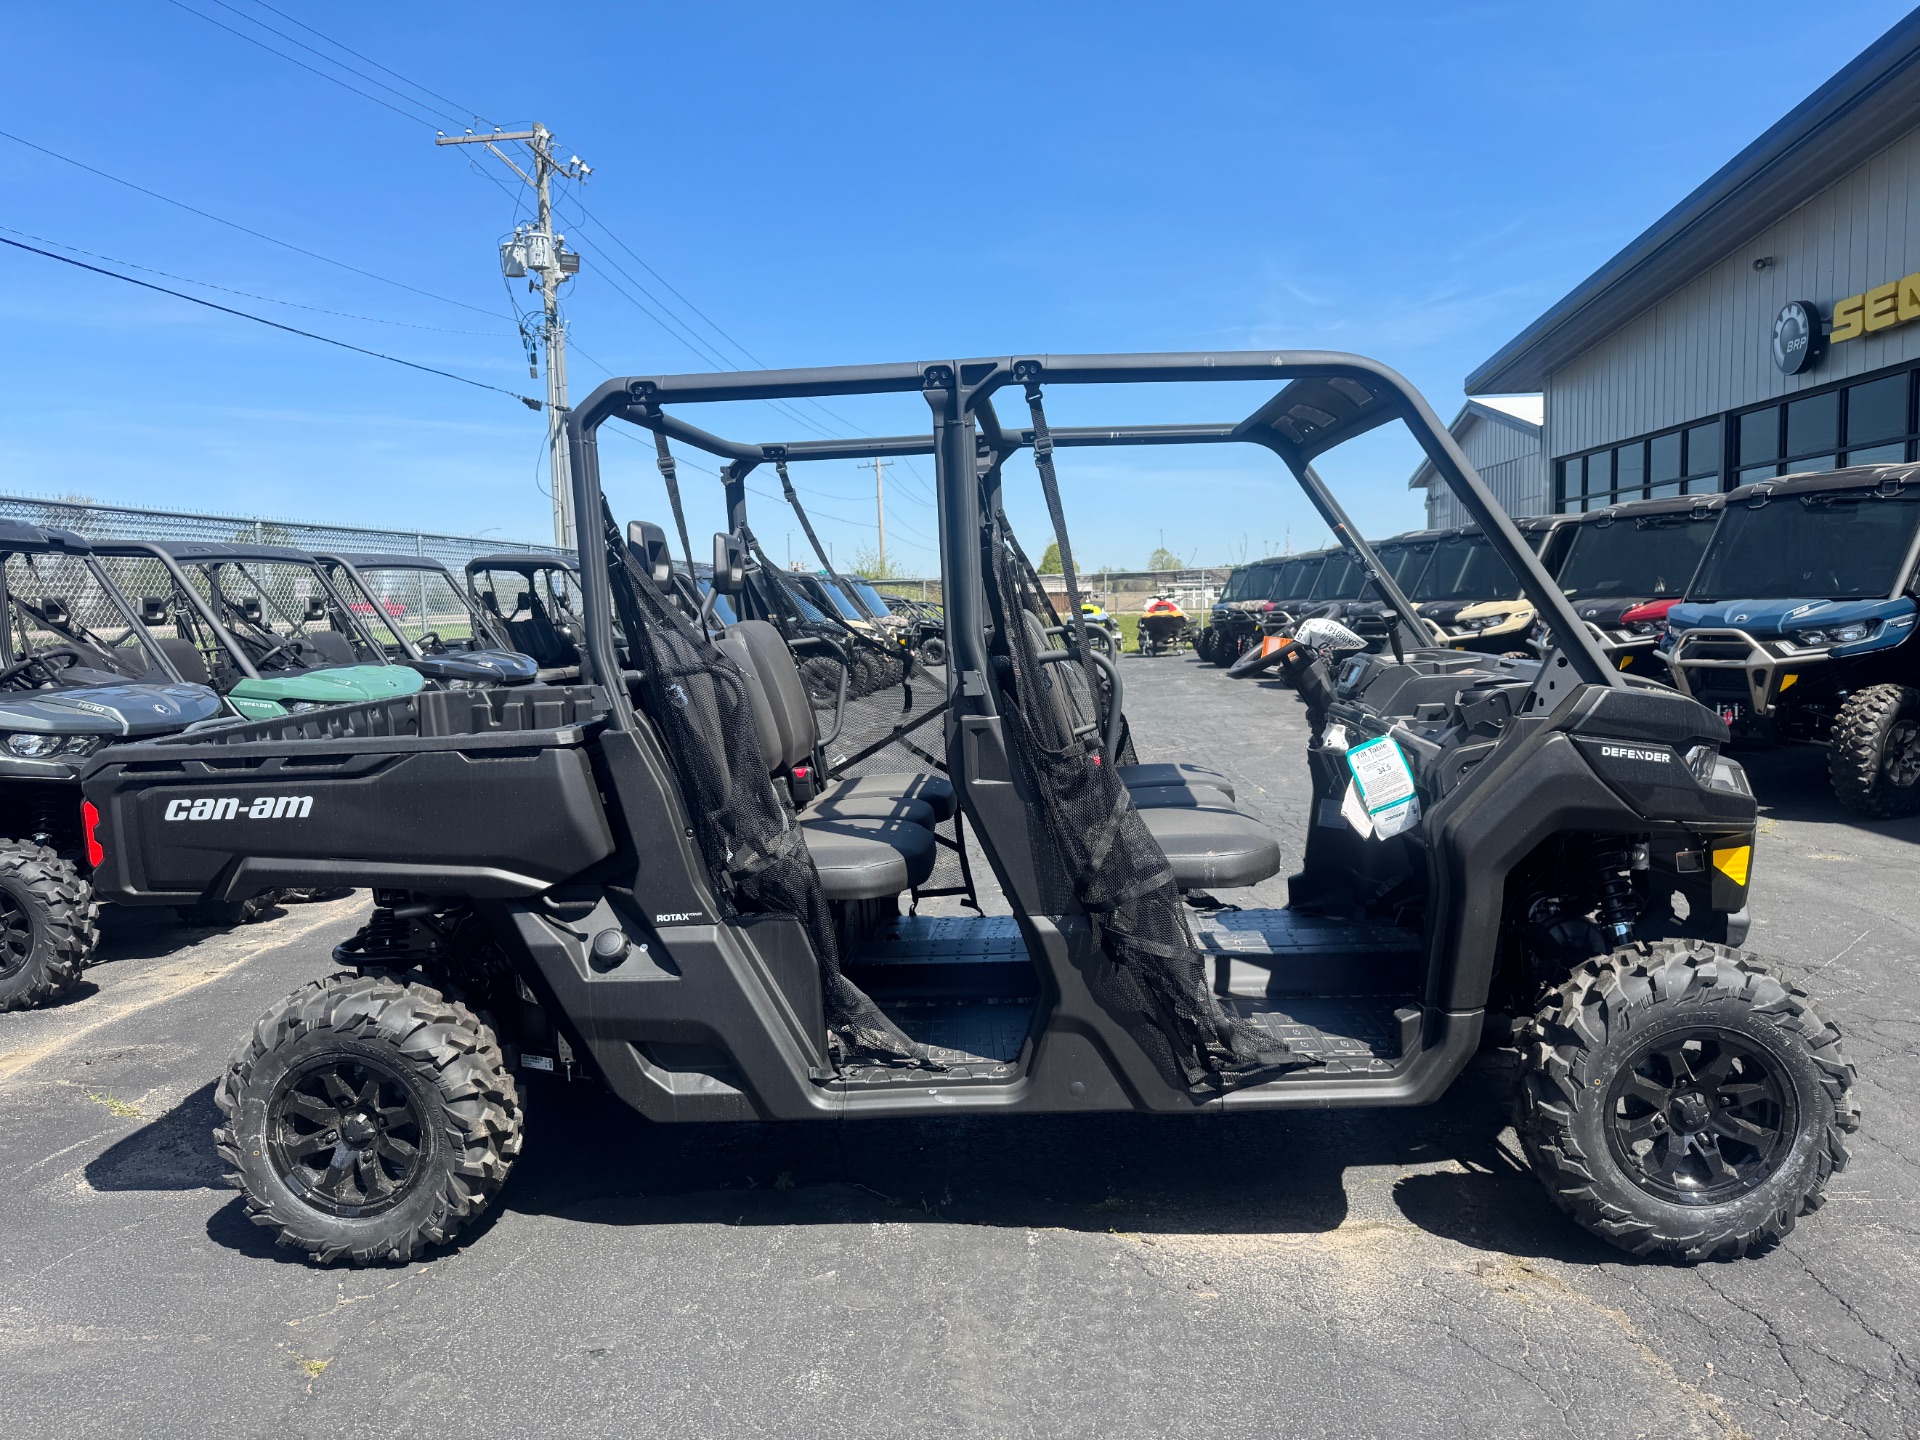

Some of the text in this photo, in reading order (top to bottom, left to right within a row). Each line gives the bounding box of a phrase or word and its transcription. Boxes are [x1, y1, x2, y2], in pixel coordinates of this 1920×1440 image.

[1786, 336, 1807, 353] BRP
[77, 702, 105, 712] HD10
[240, 700, 273, 709] DEFENDER
[1355, 743, 1388, 760] Tilt Table
[1601, 746, 1671, 763] DEFENDER
[1377, 763, 1392, 775] 34.5
[164, 795, 314, 821] can-am
[656, 913, 690, 922] ROTAX
